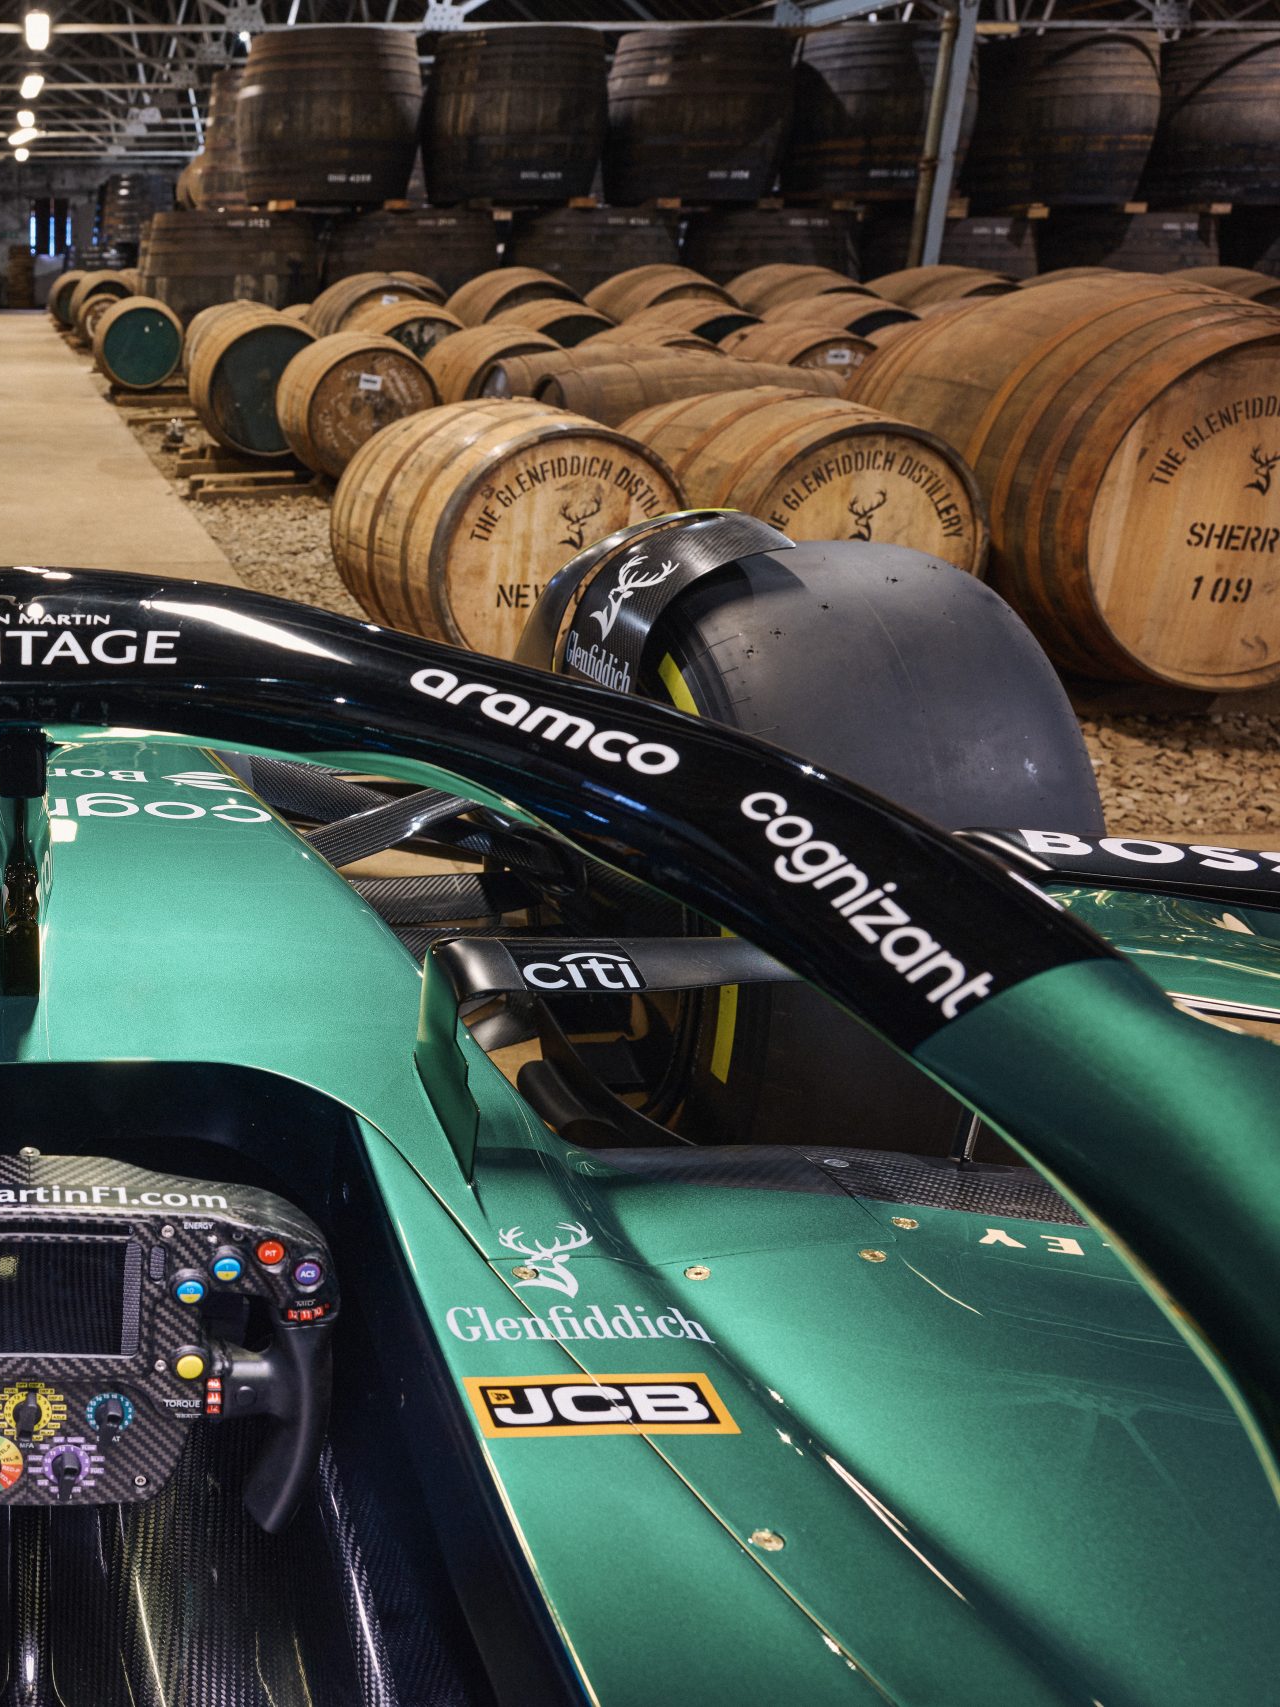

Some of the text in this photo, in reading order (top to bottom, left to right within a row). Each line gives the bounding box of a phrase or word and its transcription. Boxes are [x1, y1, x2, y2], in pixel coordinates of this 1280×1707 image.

[1148, 395, 1280, 485] THE GLENFIDD
[469, 505, 502, 542] THE
[495, 455, 615, 508] GLENFIDDICH
[783, 450, 897, 512] GLENFIDDICH
[897, 455, 965, 539] DISTILLERY
[1186, 521, 1280, 553] SHERR
[19, 613, 111, 626] MARTIN
[565, 629, 632, 694] Glenfiddich
[410, 668, 680, 775] aramco
[740, 791, 995, 1020] cognizant
[522, 951, 640, 992] citi
[183, 1222, 214, 1230] ENERGY
[300, 1270, 316, 1278] ACS
[446, 1304, 716, 1345] Glenfiddich
[163, 1399, 201, 1408] TORQUE
[493, 1383, 712, 1425] JCB
